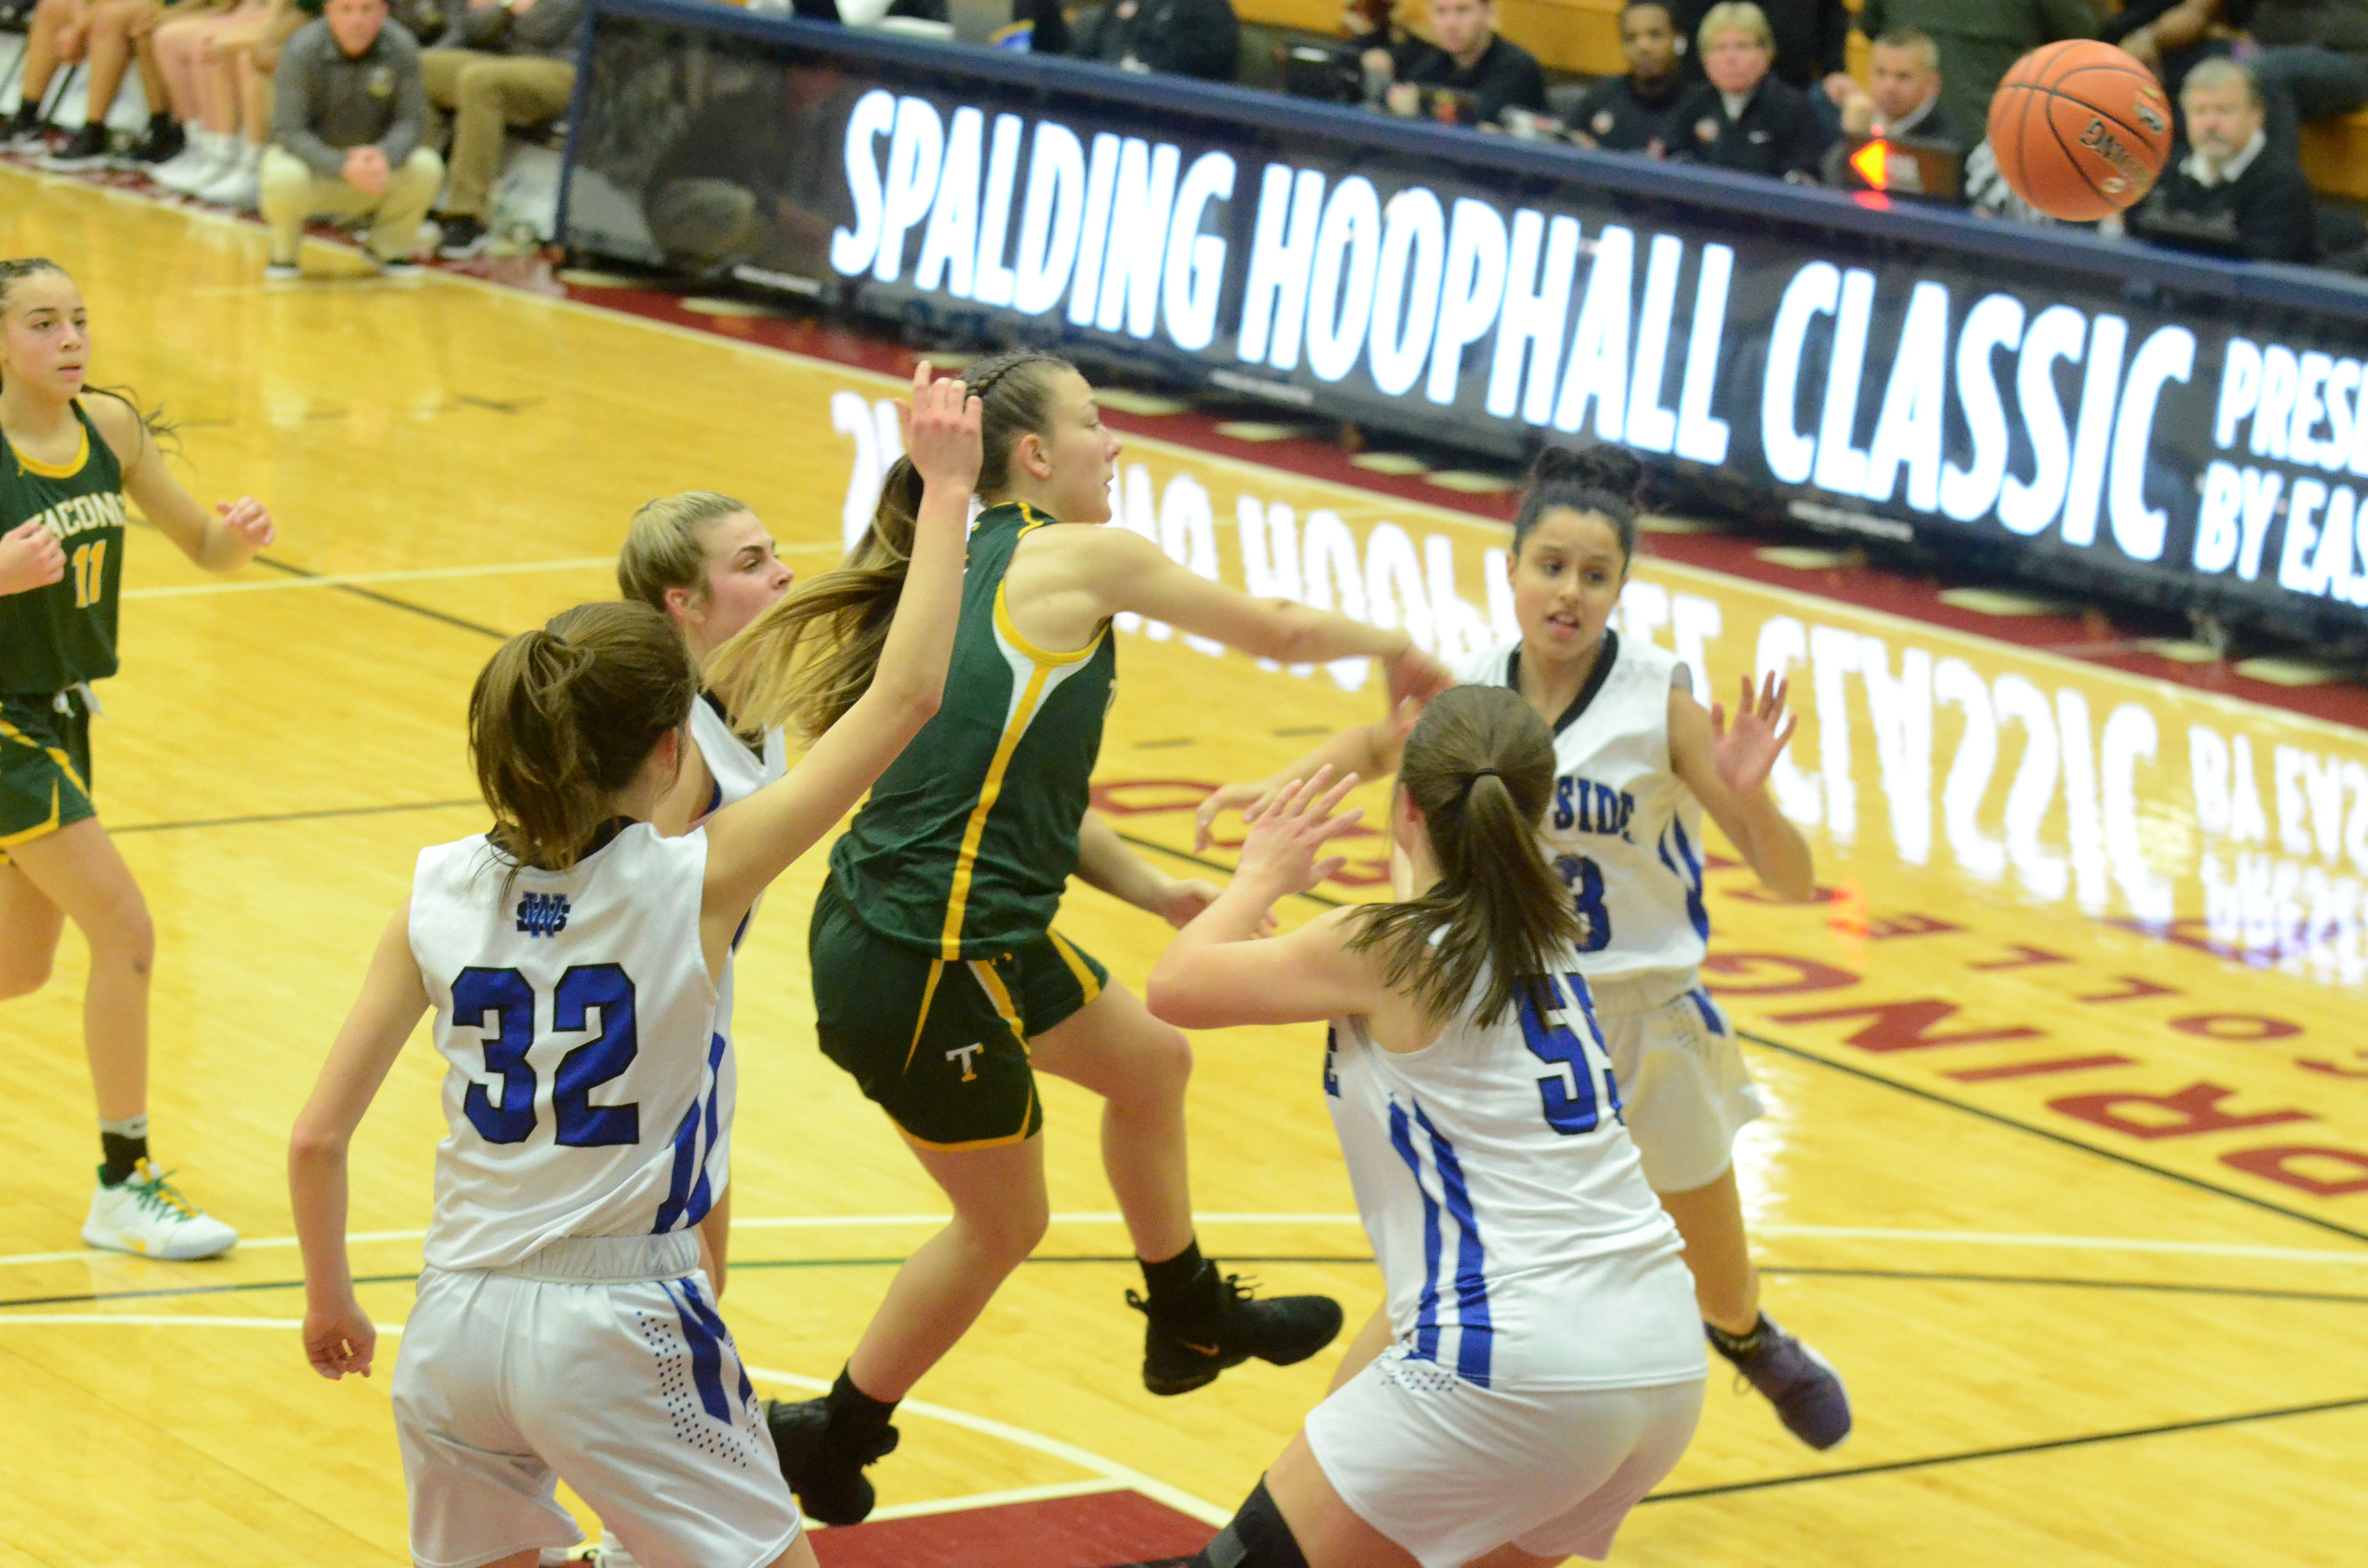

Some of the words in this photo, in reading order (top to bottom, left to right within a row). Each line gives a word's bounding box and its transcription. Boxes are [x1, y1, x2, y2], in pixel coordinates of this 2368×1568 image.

[832, 90, 1237, 351] SPALDING
[1237, 163, 1734, 465] HOOPHALL
[1762, 261, 2196, 561] CLASSIC
[72, 539, 107, 608] 11
[2192, 460, 2284, 582] BY
[450, 963, 639, 1147] 32
